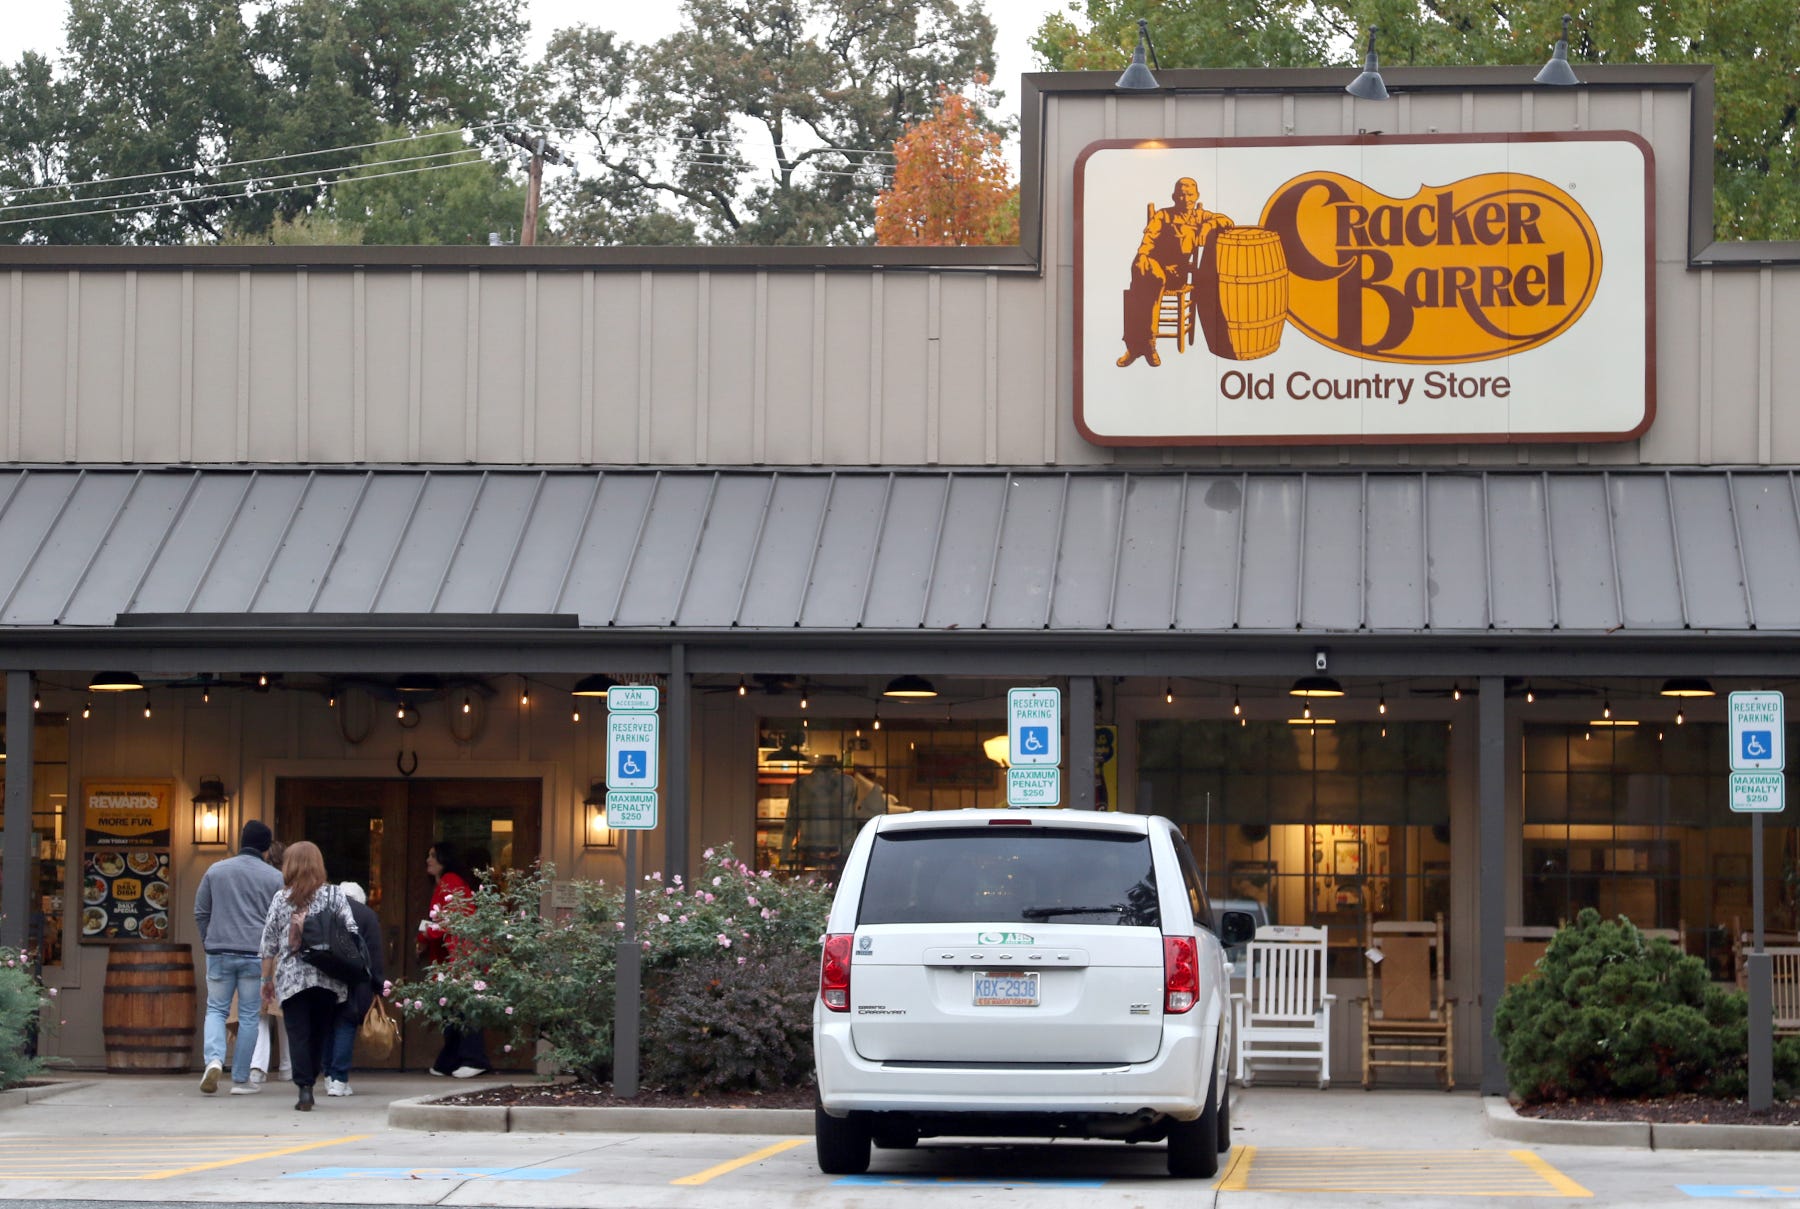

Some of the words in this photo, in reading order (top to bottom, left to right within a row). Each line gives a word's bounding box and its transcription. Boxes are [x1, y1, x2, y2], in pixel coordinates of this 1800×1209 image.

[1220, 371, 1274, 400] Old
[1287, 371, 1415, 404] Country
[1424, 370, 1511, 399] Store
[1013, 699, 1055, 708] RESERVED
[1734, 703, 1778, 711] RESERVED
[1017, 710, 1052, 718] PARKING
[1738, 714, 1775, 722] PARKING
[612, 723, 653, 732] RESERVED
[615, 734, 650, 742] PARKING
[1011, 771, 1056, 779] MAXIMUM
[1012, 780, 1054, 788] PENALTY
[1733, 776, 1780, 784] MAXIMUM
[1023, 789, 1044, 797] $250
[1735, 785, 1778, 793] PENALTY
[1745, 794, 1768, 802] $250
[620, 812, 642, 820] $250
[98, 818, 128, 826] MORE
[131, 818, 153, 826] FUN.
[975, 980, 1036, 997] KBX-2938
